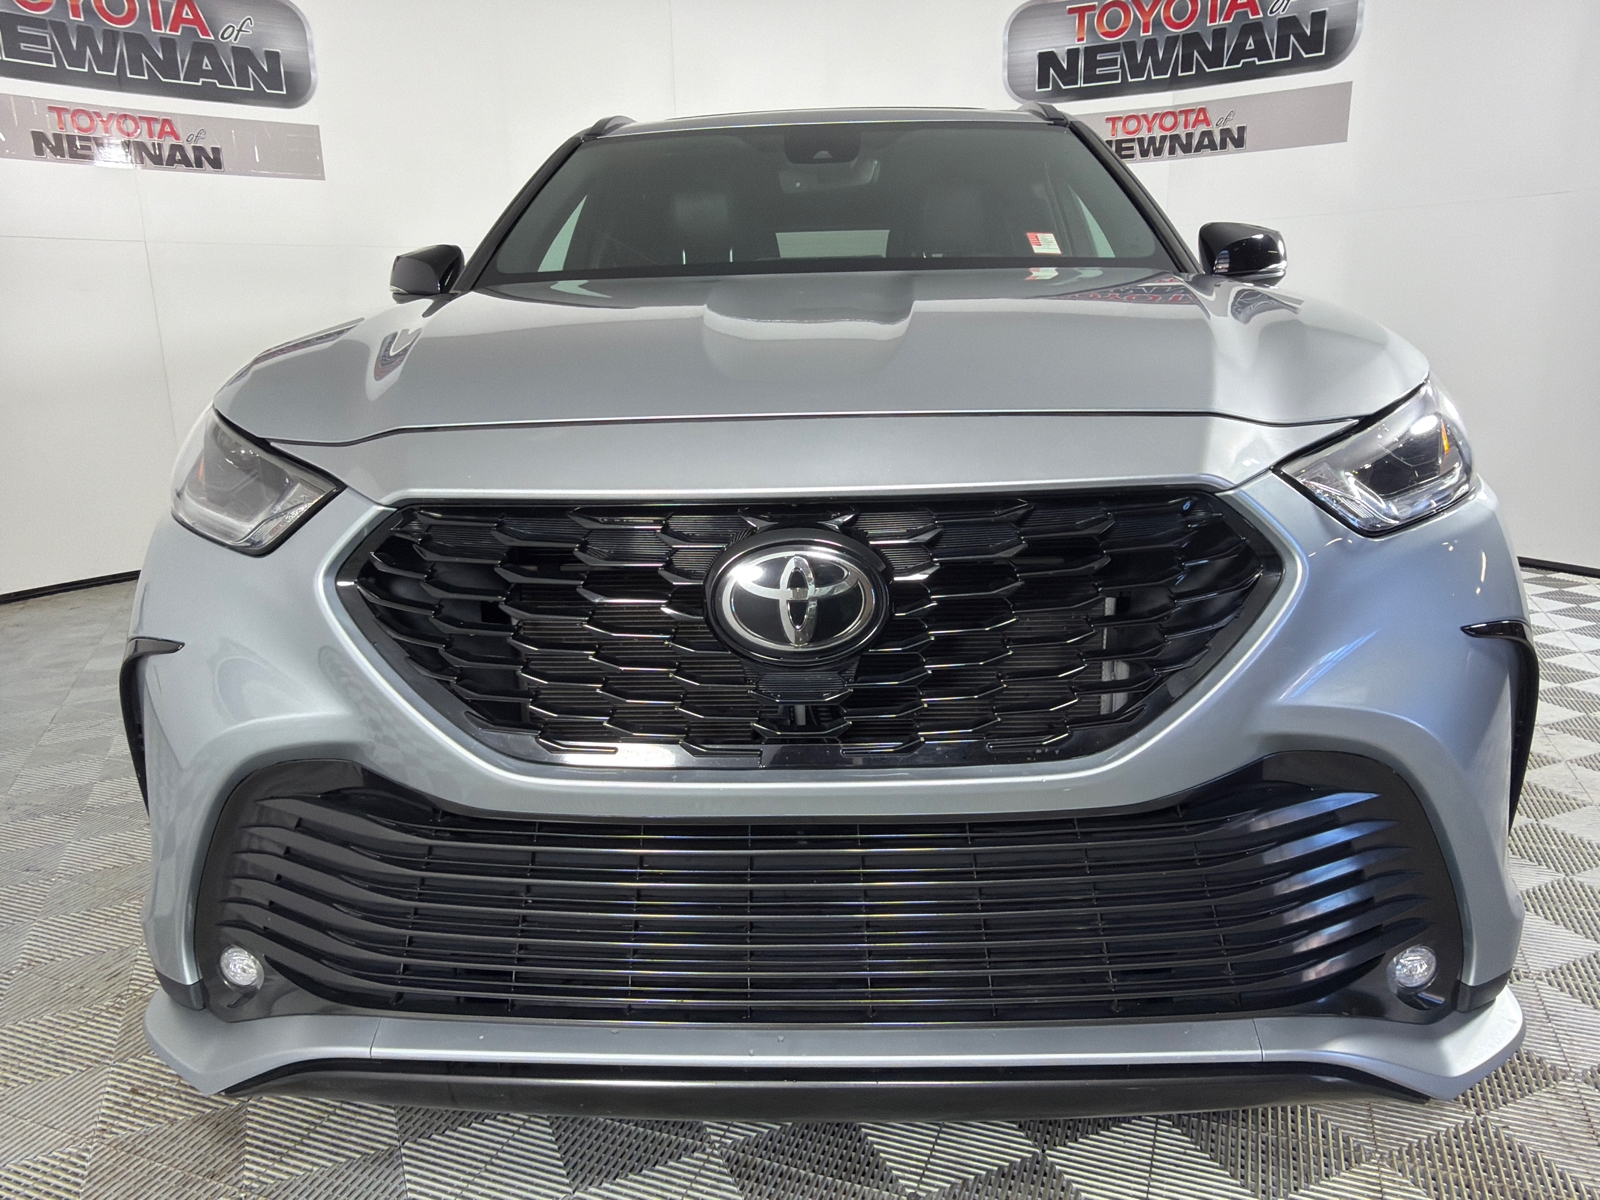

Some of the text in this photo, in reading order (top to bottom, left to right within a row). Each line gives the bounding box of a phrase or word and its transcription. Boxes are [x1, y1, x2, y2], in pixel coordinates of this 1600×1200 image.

[13, 0, 254, 43] OTA of
[0, 10, 287, 95] EWNAN
[1036, 8, 1328, 92] NEWNAN
[47, 105, 206, 144] TOYOTA of
[1105, 106, 1235, 137] TOYOTA of
